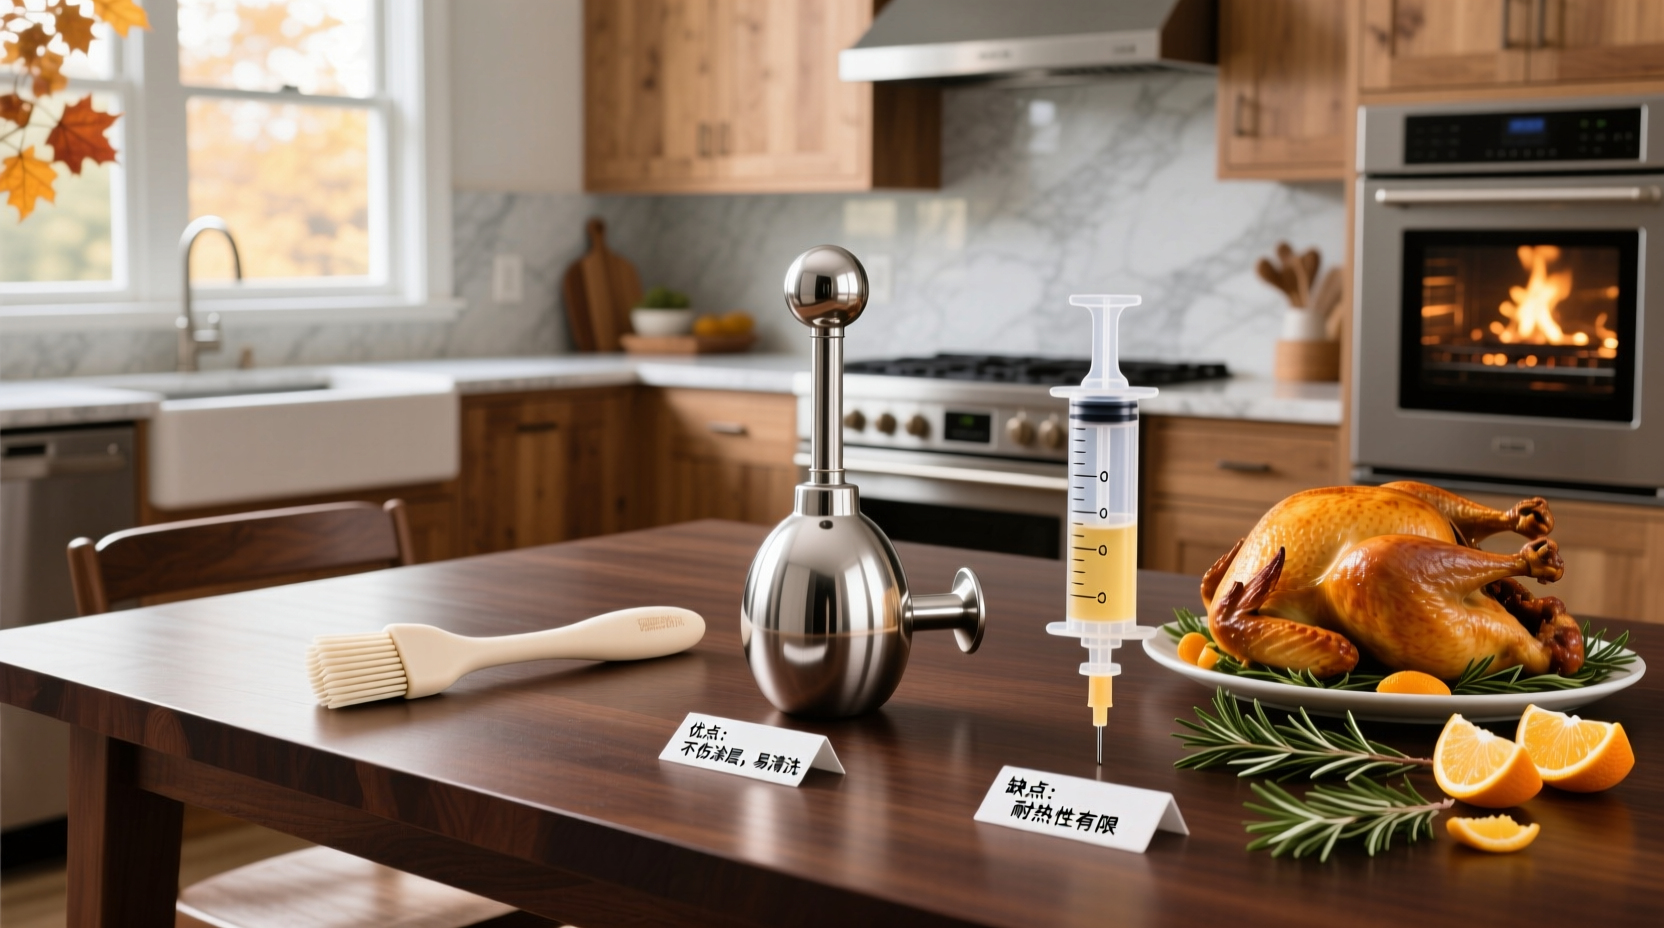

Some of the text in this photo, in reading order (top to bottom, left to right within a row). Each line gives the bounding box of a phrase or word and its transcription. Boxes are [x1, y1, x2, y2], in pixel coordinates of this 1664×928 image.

[1010, 799, 1119, 835] 耐热性有限
